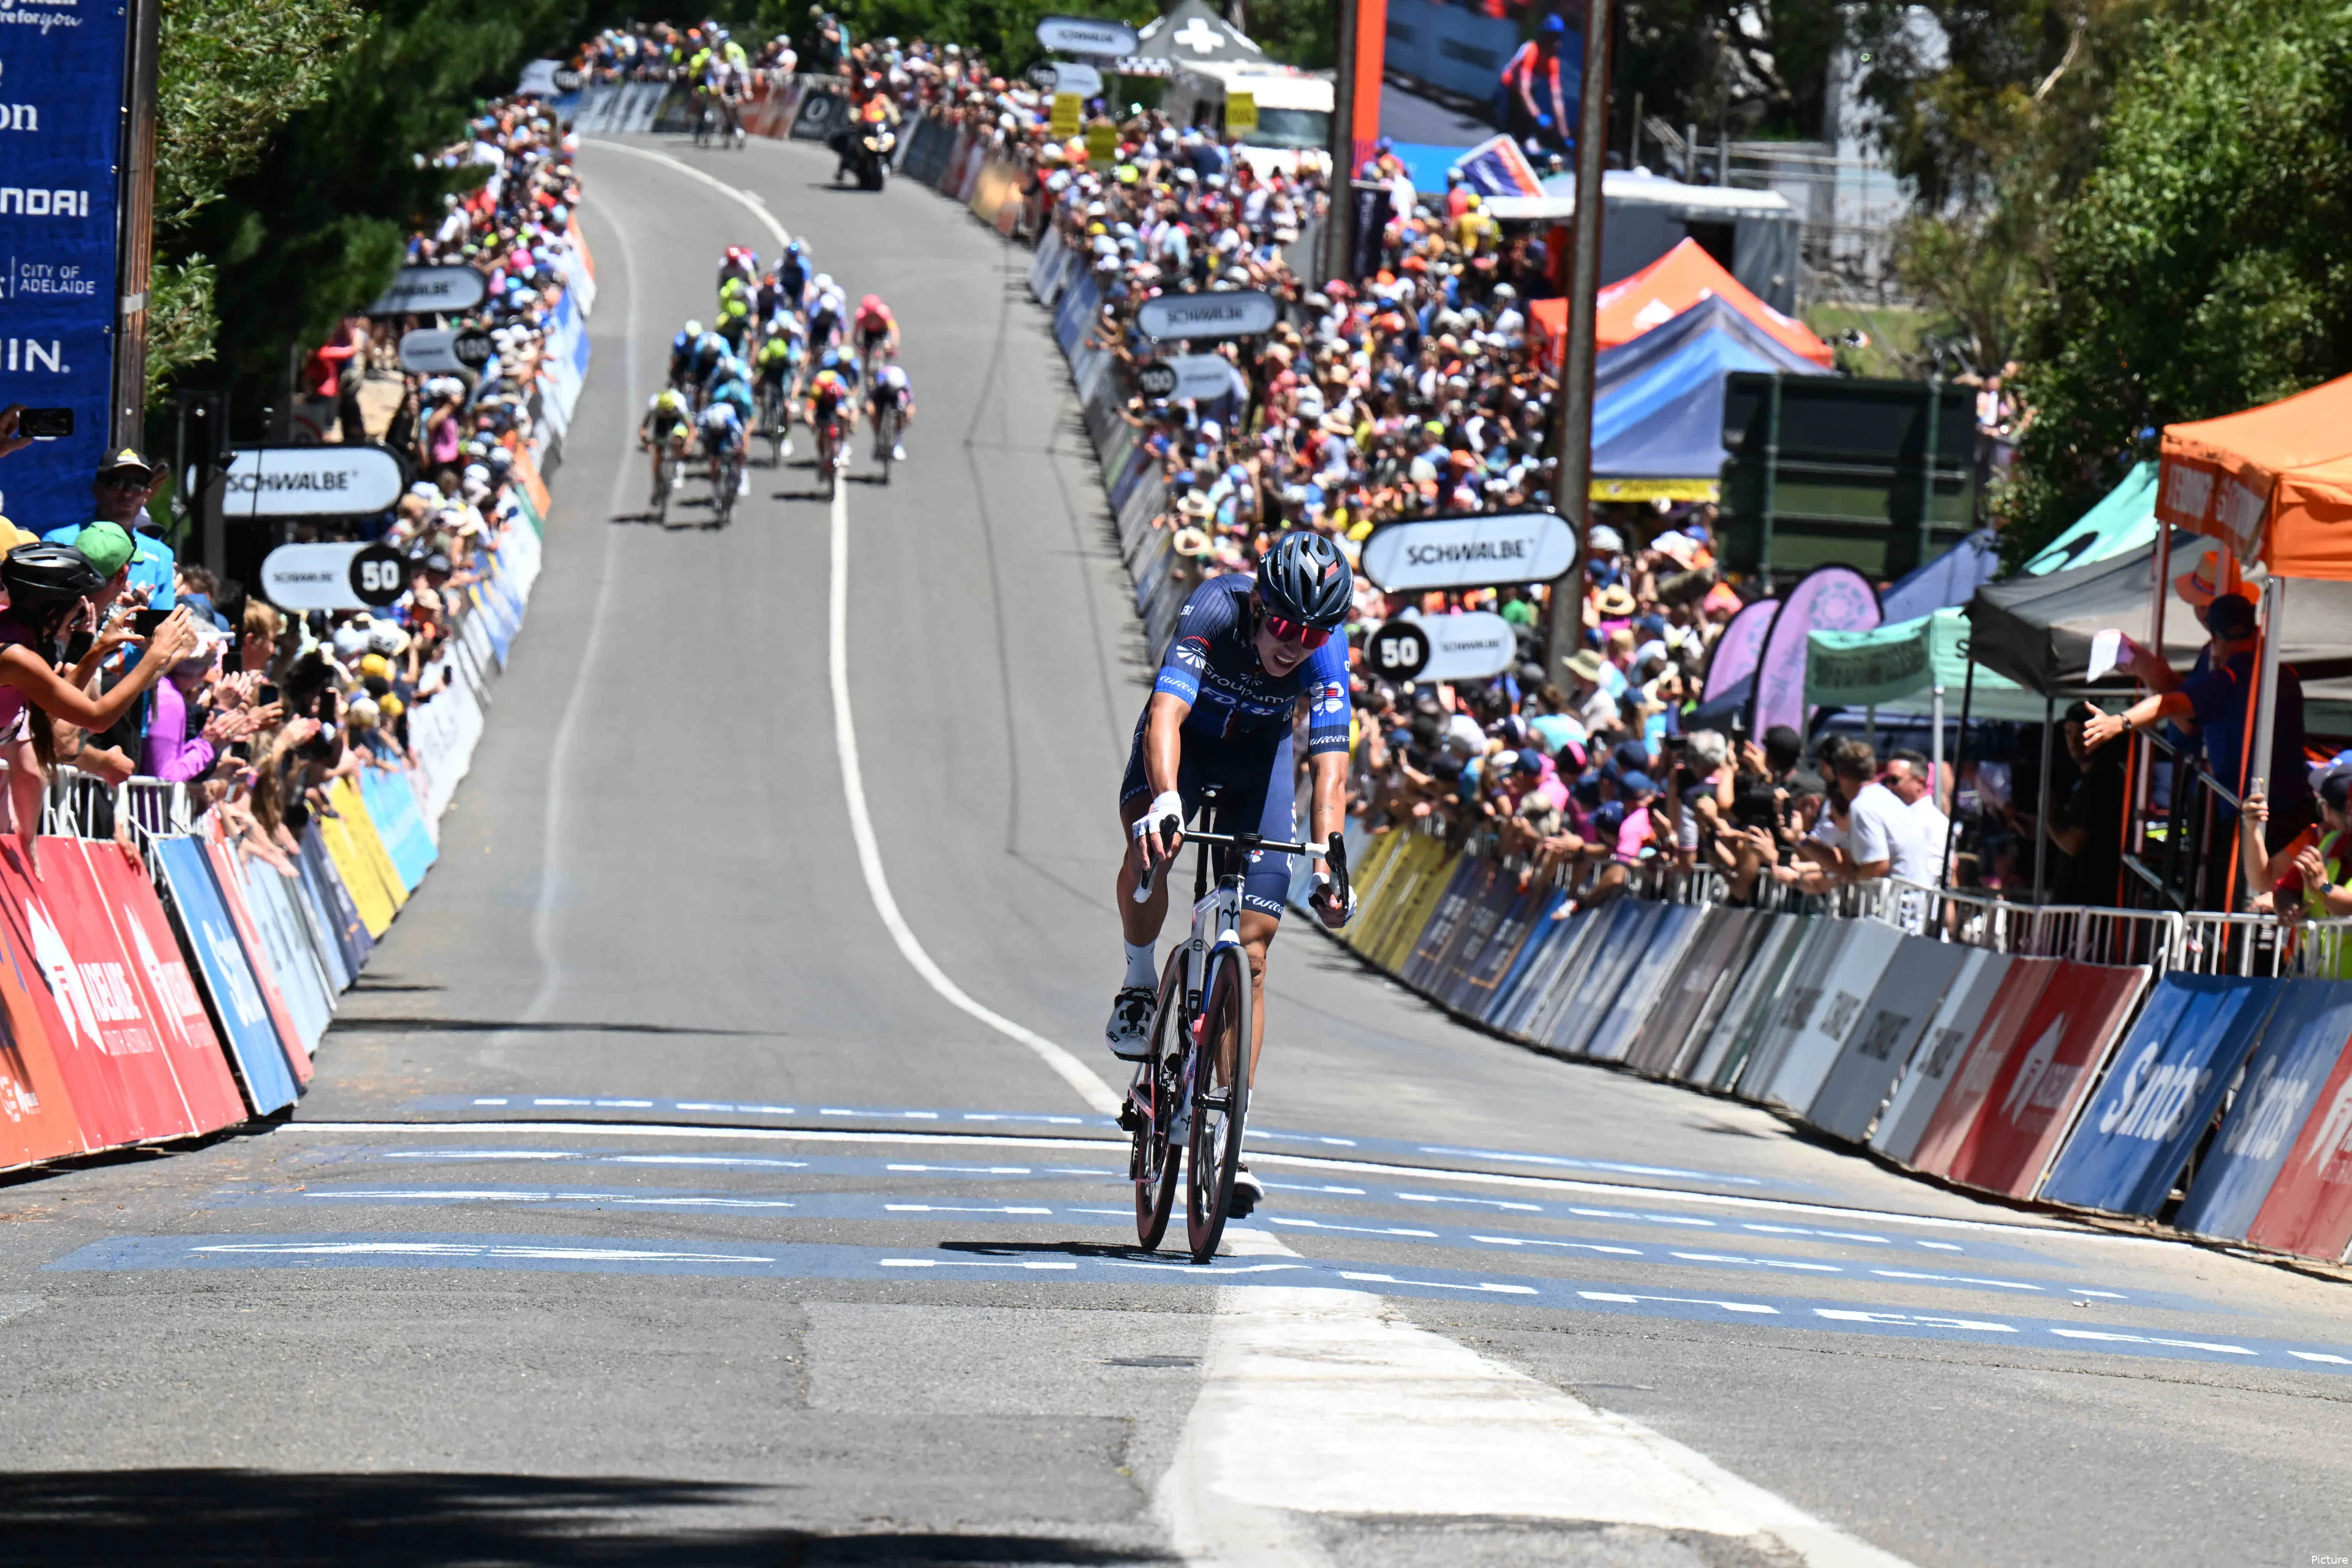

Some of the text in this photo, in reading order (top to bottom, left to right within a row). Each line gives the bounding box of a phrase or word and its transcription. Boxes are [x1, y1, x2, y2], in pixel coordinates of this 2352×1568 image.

[21, 263, 80, 279] CITY OF
[20, 279, 95, 295] ADELAIDE
[226, 470, 348, 491] SCHWALBE
[1406, 539, 1527, 566] SCHWALBE
[361, 560, 400, 591] 50
[1380, 636, 1419, 668] 50
